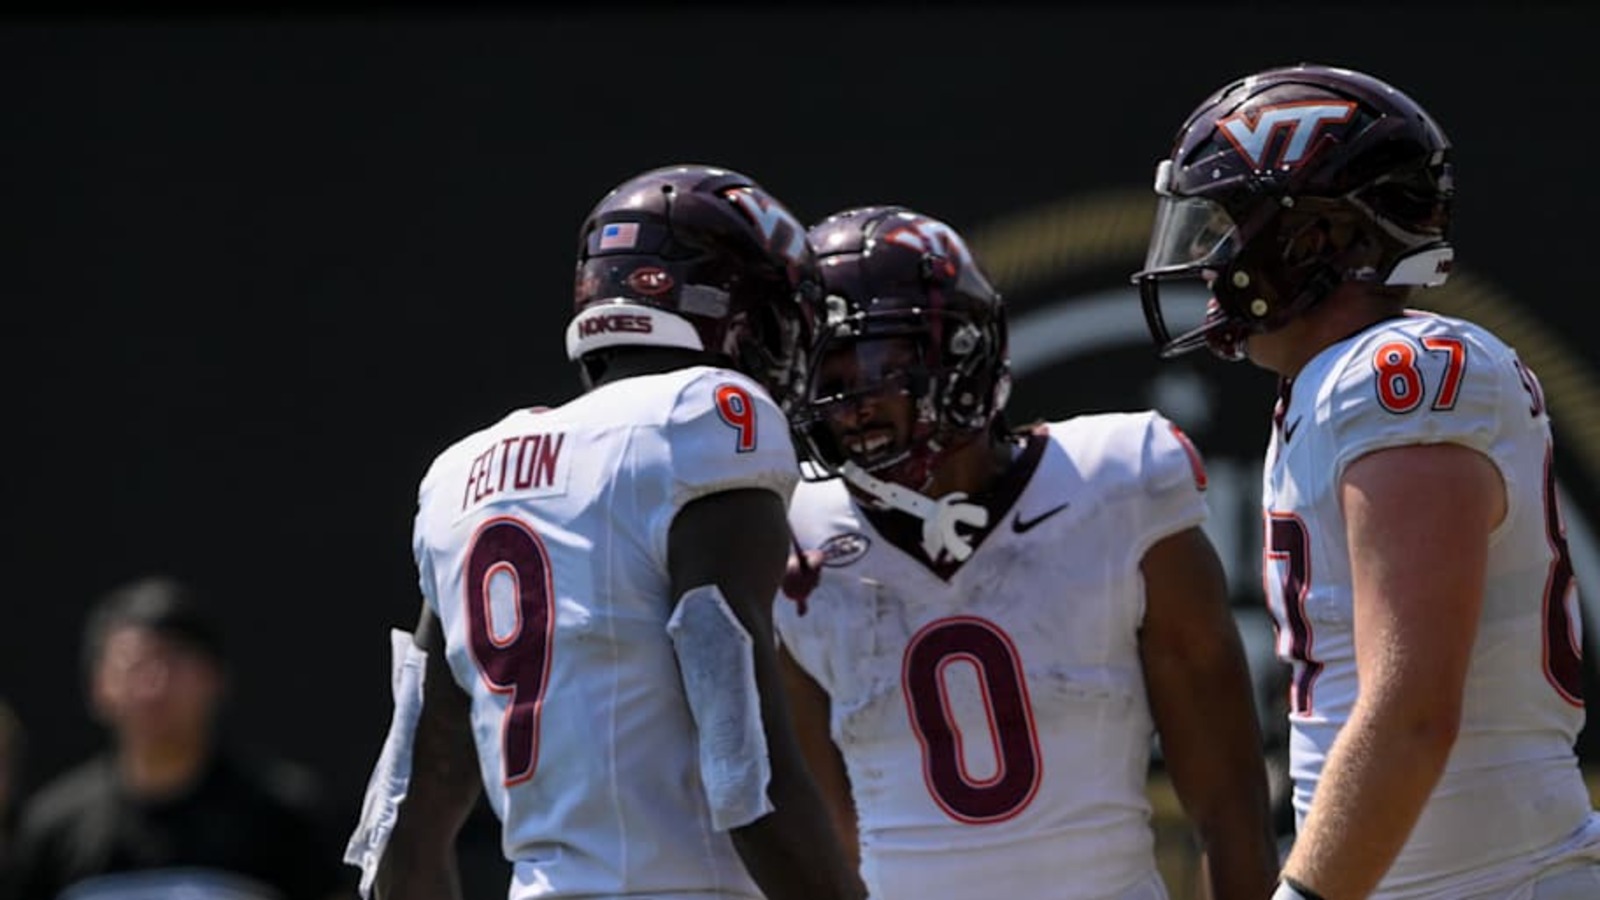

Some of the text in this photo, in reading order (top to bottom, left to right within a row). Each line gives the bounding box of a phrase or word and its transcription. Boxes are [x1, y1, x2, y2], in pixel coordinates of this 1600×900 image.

[1216, 100, 1358, 169] VT
[1373, 336, 1466, 414] 87
[713, 383, 757, 454] 9
[462, 432, 566, 511] FELTON
[463, 515, 555, 787] 9
[902, 615, 1043, 826] 0
